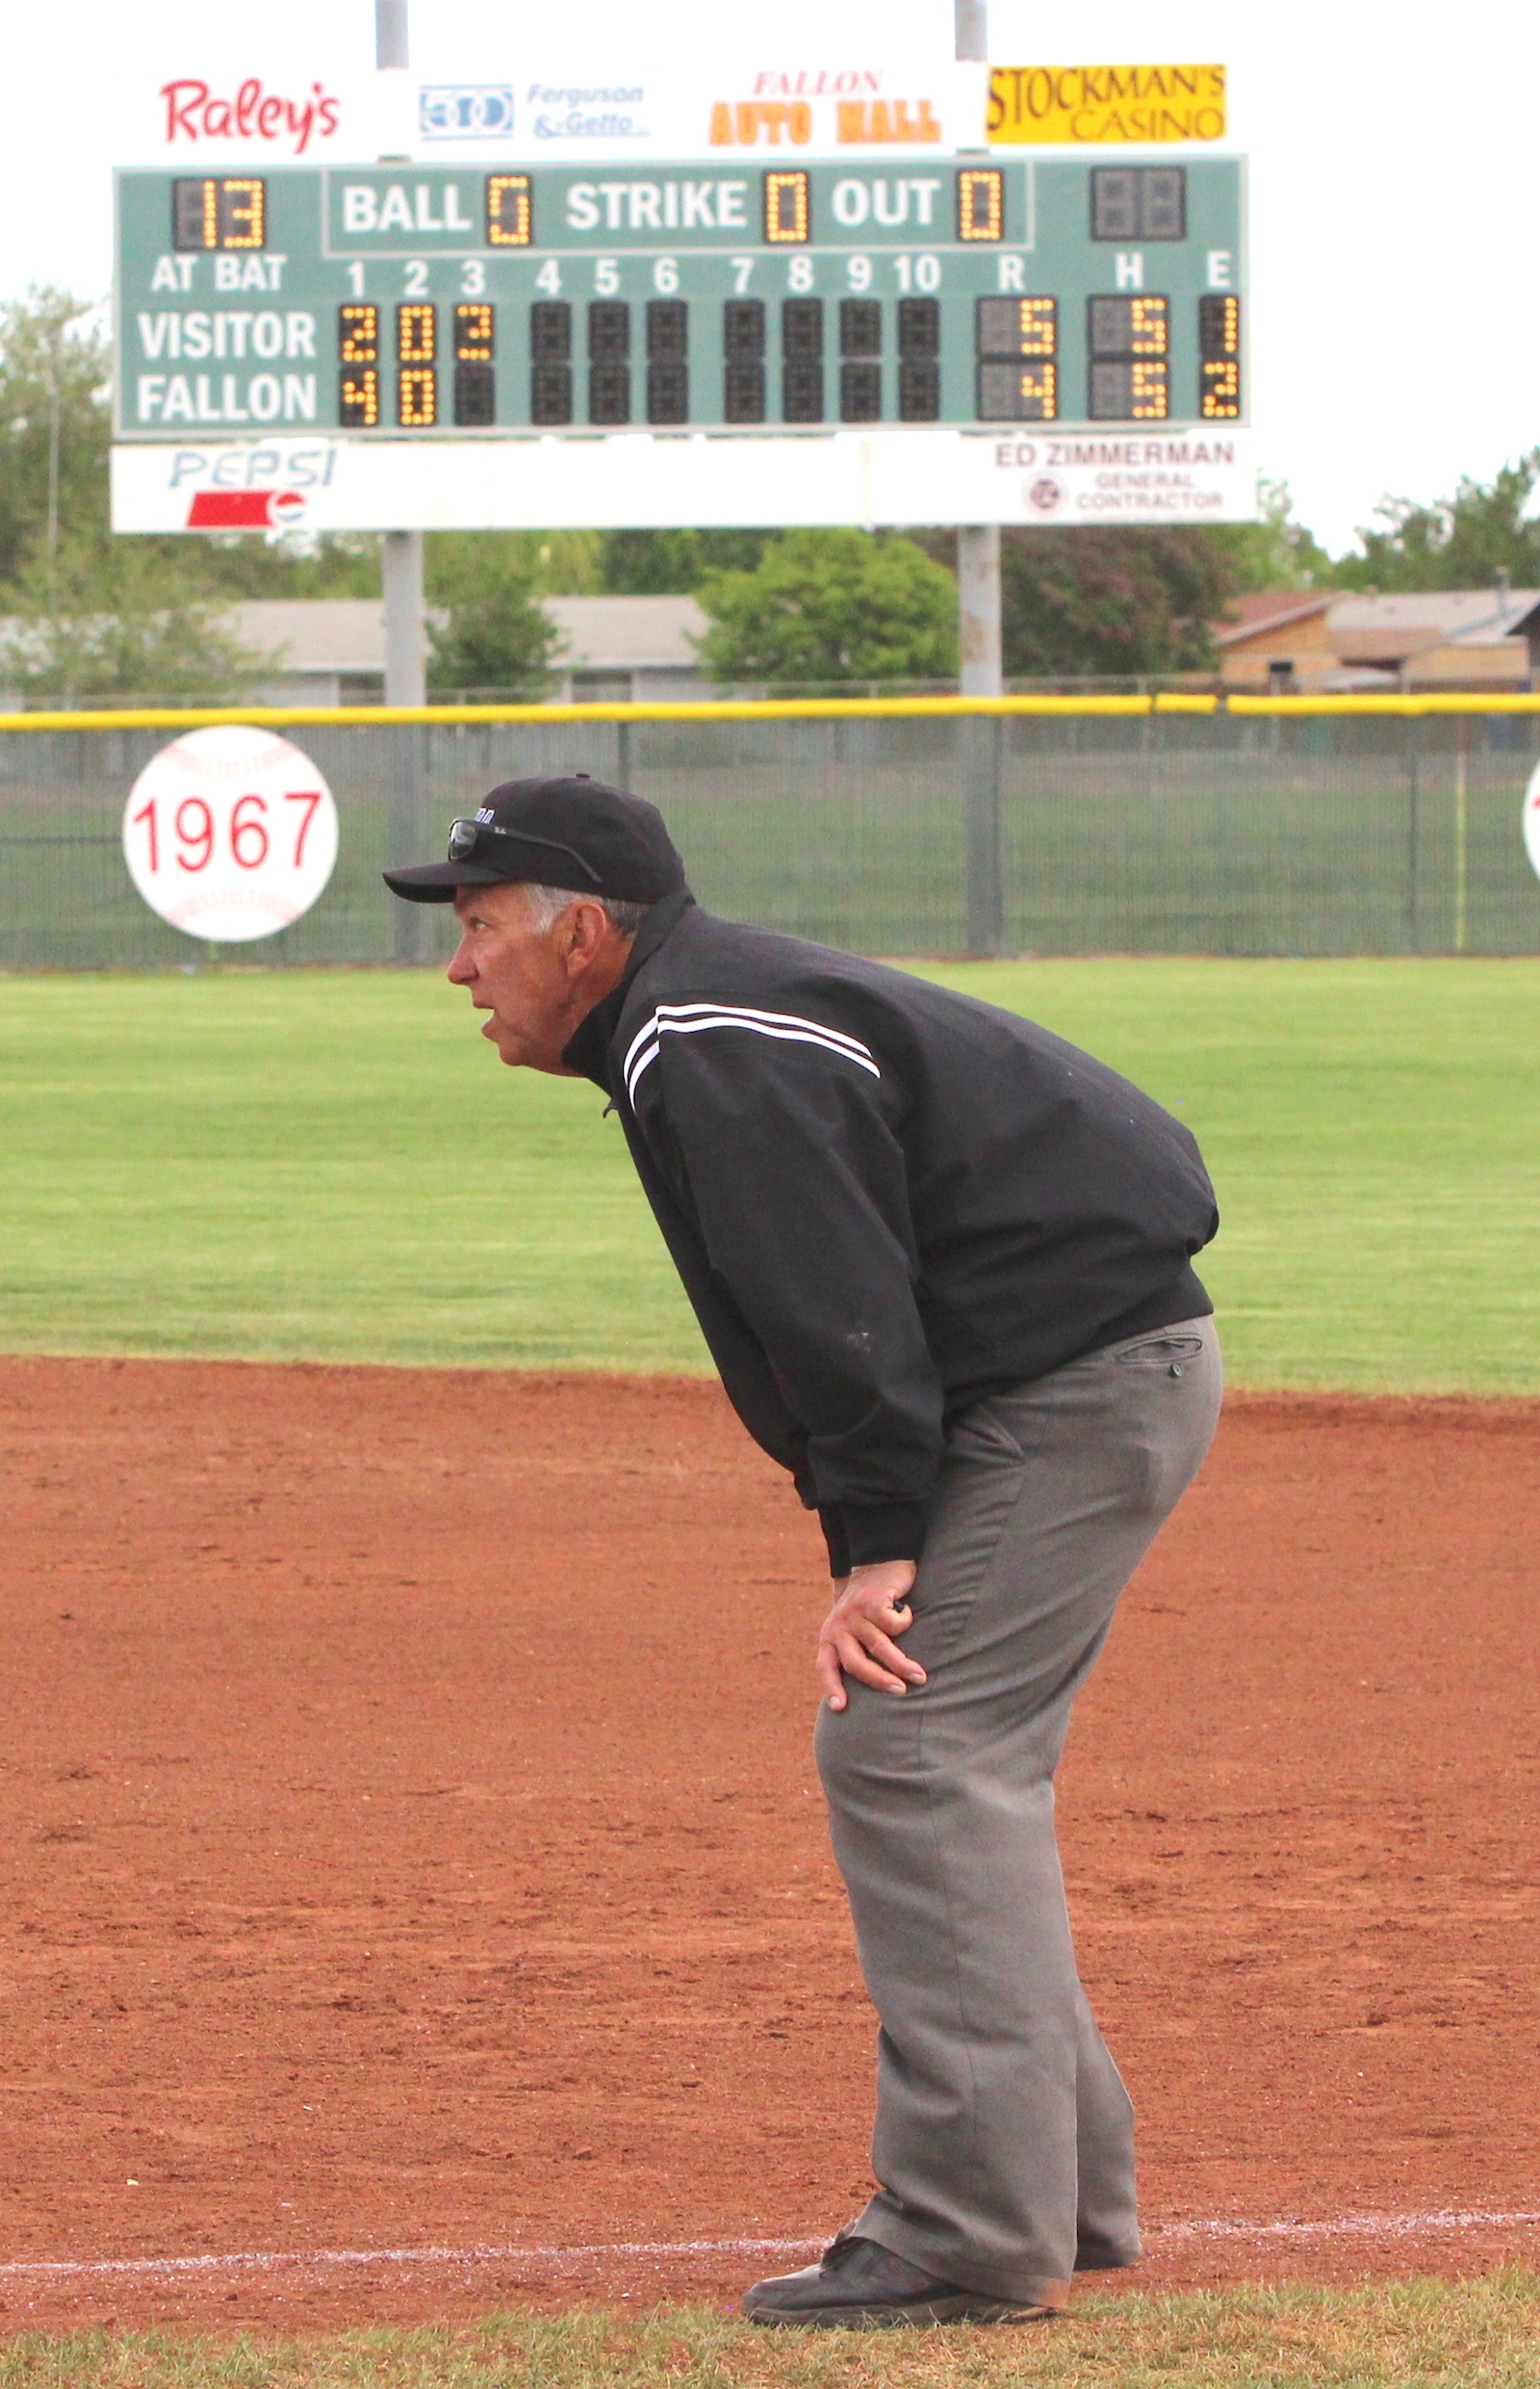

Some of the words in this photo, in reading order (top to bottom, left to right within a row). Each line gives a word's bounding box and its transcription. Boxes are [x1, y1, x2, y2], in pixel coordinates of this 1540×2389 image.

[526, 83, 644, 108] Ferguson
[754, 70, 883, 94] FALLON
[987, 64, 1223, 131] STOCKMAN'S
[160, 78, 340, 155] Raley's
[709, 100, 812, 145] AUTO
[836, 99, 940, 143] MALL
[1070, 107, 1224, 141] CASINO
[203, 179, 264, 249] 13
[344, 185, 472, 232] BALL
[489, 175, 529, 245] 0
[566, 180, 747, 229] STRIKE
[766, 172, 807, 241] 0
[832, 179, 940, 227] OUT
[959, 171, 1001, 240] 0
[150, 255, 196, 291] AT
[215, 254, 286, 291] BAT
[347, 261, 365, 297] 1
[404, 260, 428, 296] 2
[461, 260, 485, 295] 3
[536, 259, 561, 295] 4
[595, 259, 620, 294] 5
[654, 258, 678, 293] 6
[731, 257, 754, 292] 7
[788, 256, 813, 292] 8
[848, 255, 872, 291] 9
[894, 255, 940, 291] 10
[998, 254, 1024, 290] R
[1116, 253, 1142, 289] H
[1207, 251, 1231, 287] E
[138, 312, 316, 360] VISITOR
[343, 306, 376, 362] 2
[400, 305, 434, 361] 0
[1021, 298, 1054, 354] 5
[1132, 297, 1167, 353] 5
[137, 374, 316, 422] FALLON
[344, 370, 377, 424] 4
[400, 370, 434, 424] 0
[1021, 363, 1055, 418] 4
[1132, 362, 1167, 418] 5
[1204, 361, 1238, 417] 2
[167, 449, 338, 489] PEPSI
[995, 443, 1037, 467] ED
[1047, 441, 1234, 466] ZIMMERMAN
[1076, 492, 1224, 509] CONTRACTOR
[1095, 472, 1194, 489] GENERAL
[134, 791, 322, 873] 1967
